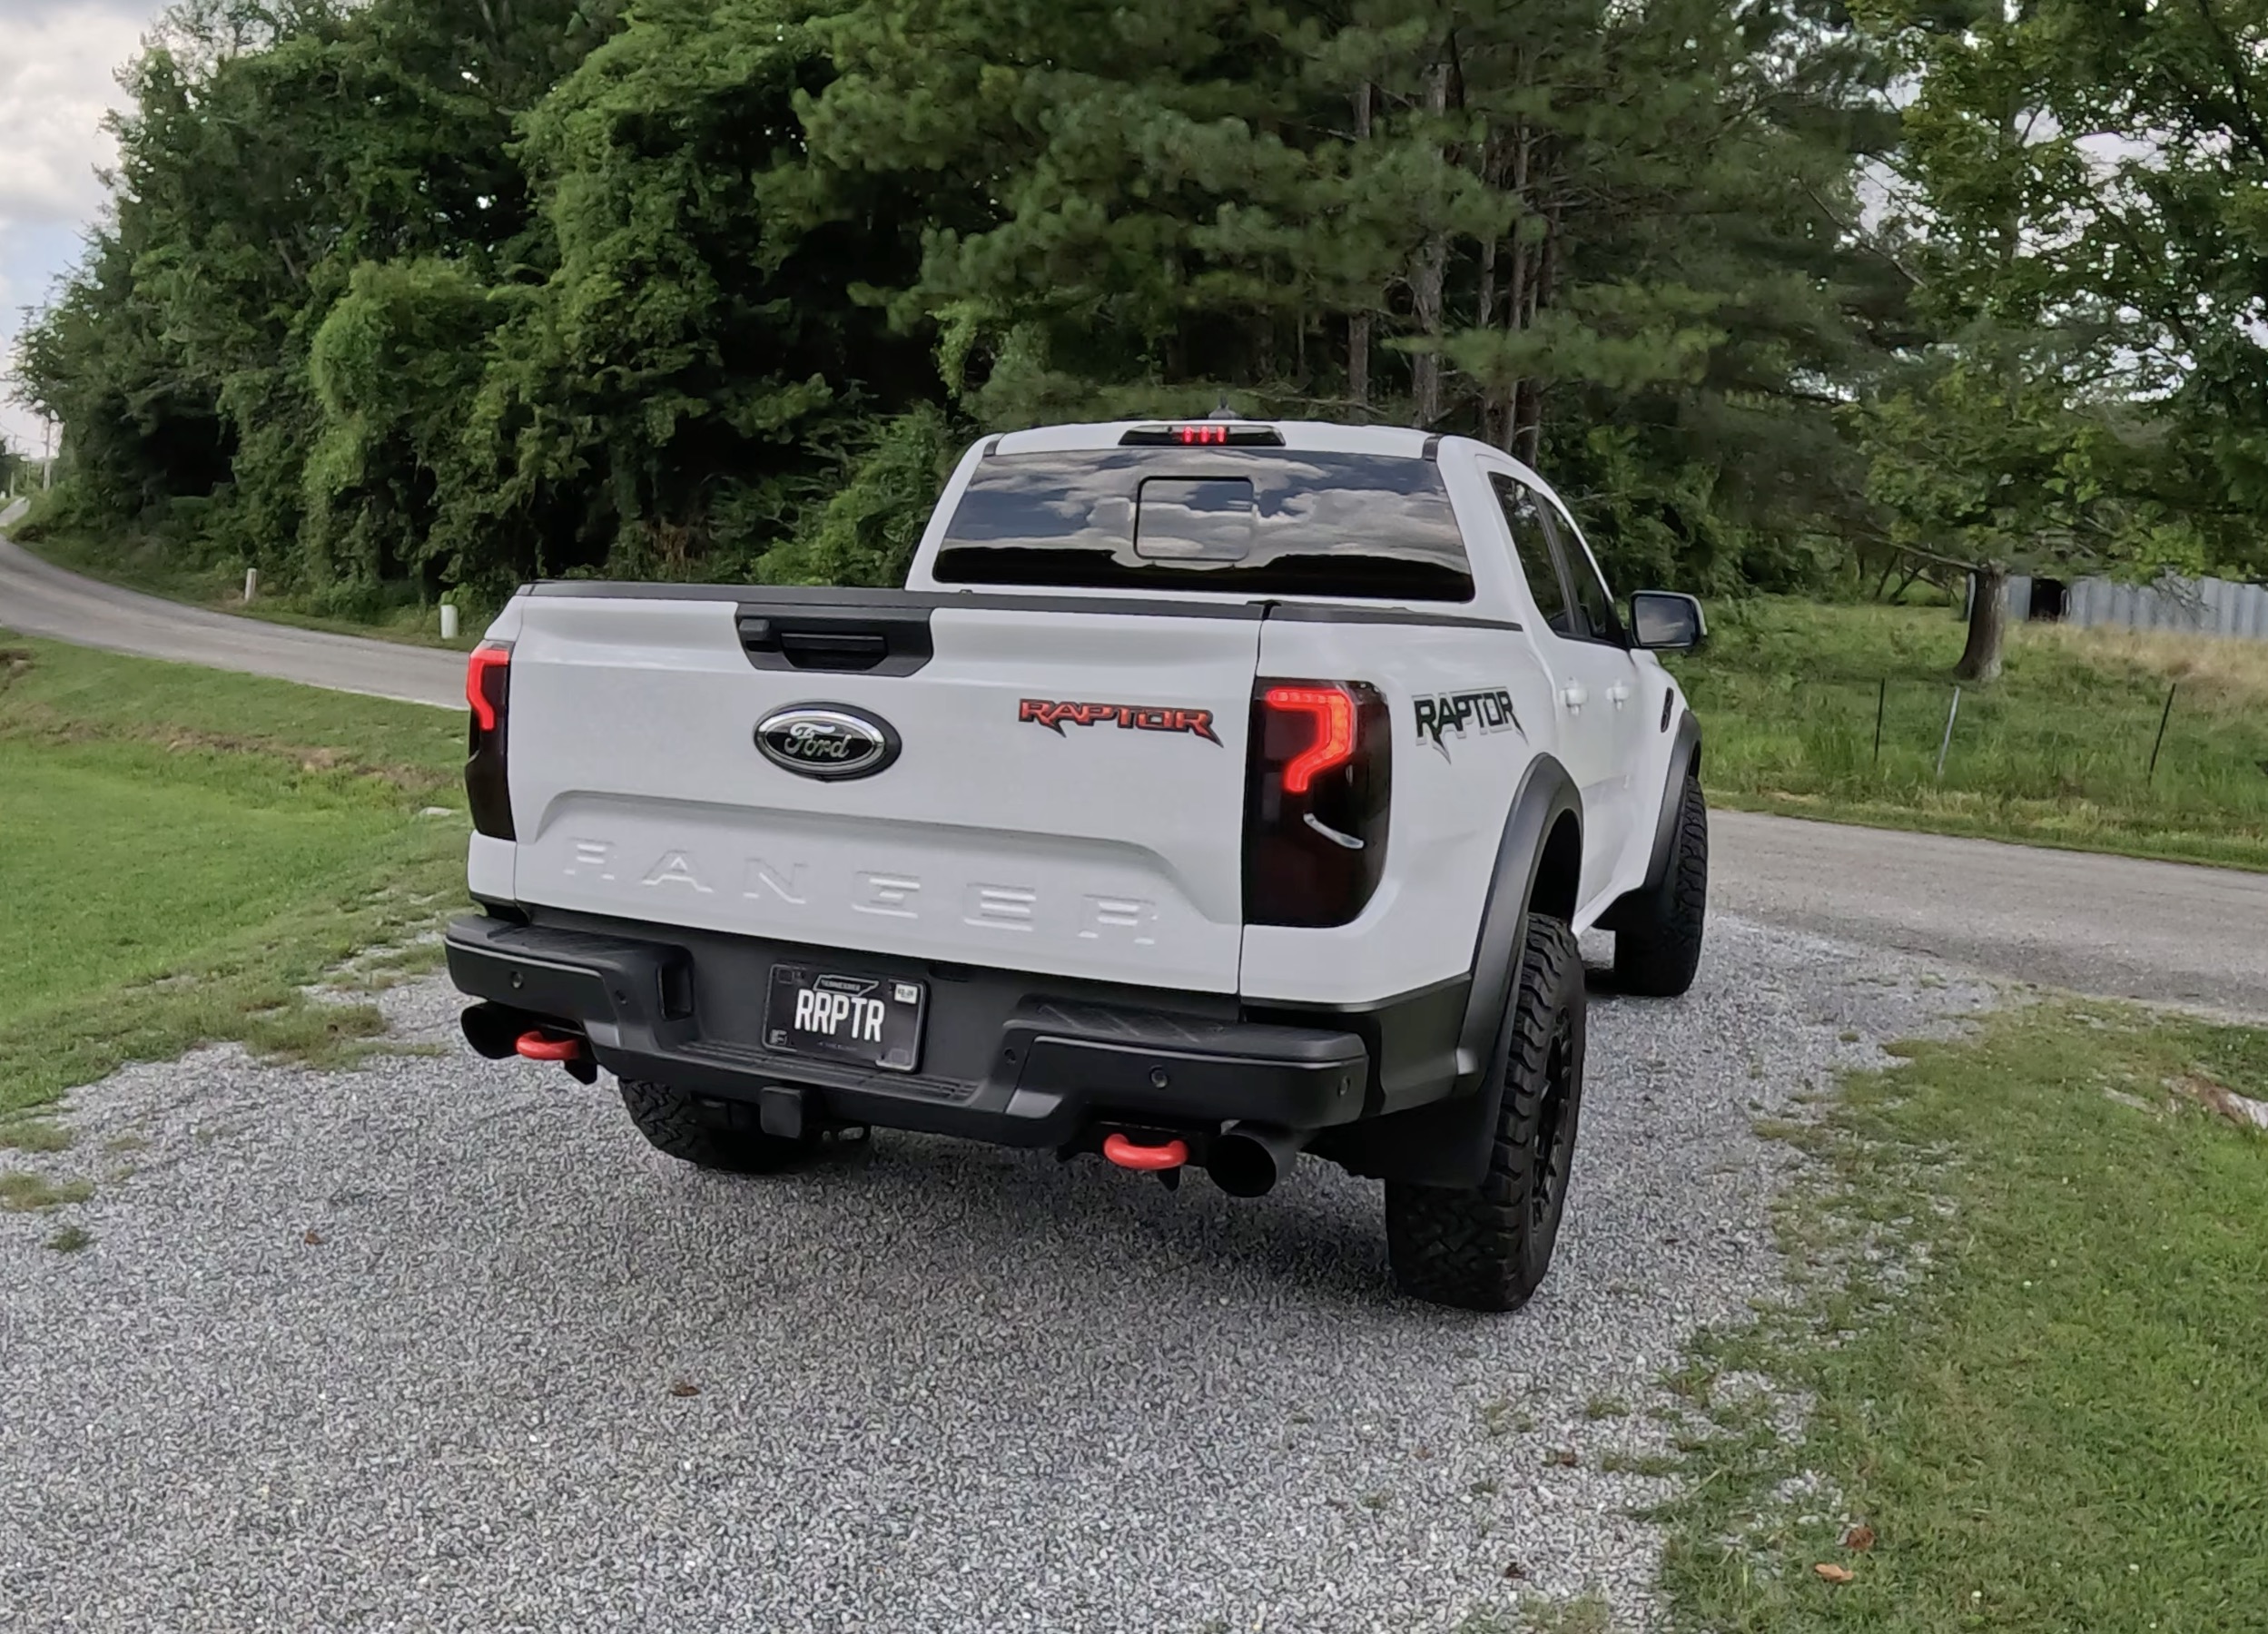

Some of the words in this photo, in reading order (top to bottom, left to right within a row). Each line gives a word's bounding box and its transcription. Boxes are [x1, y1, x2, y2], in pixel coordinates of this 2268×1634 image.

[784, 722, 852, 758] Ford
[1019, 698, 1224, 748] RAPTOR
[1411, 686, 1529, 764] RAPTOR
[564, 836, 1158, 947] RANGER
[794, 989, 885, 1042] RRPTR
